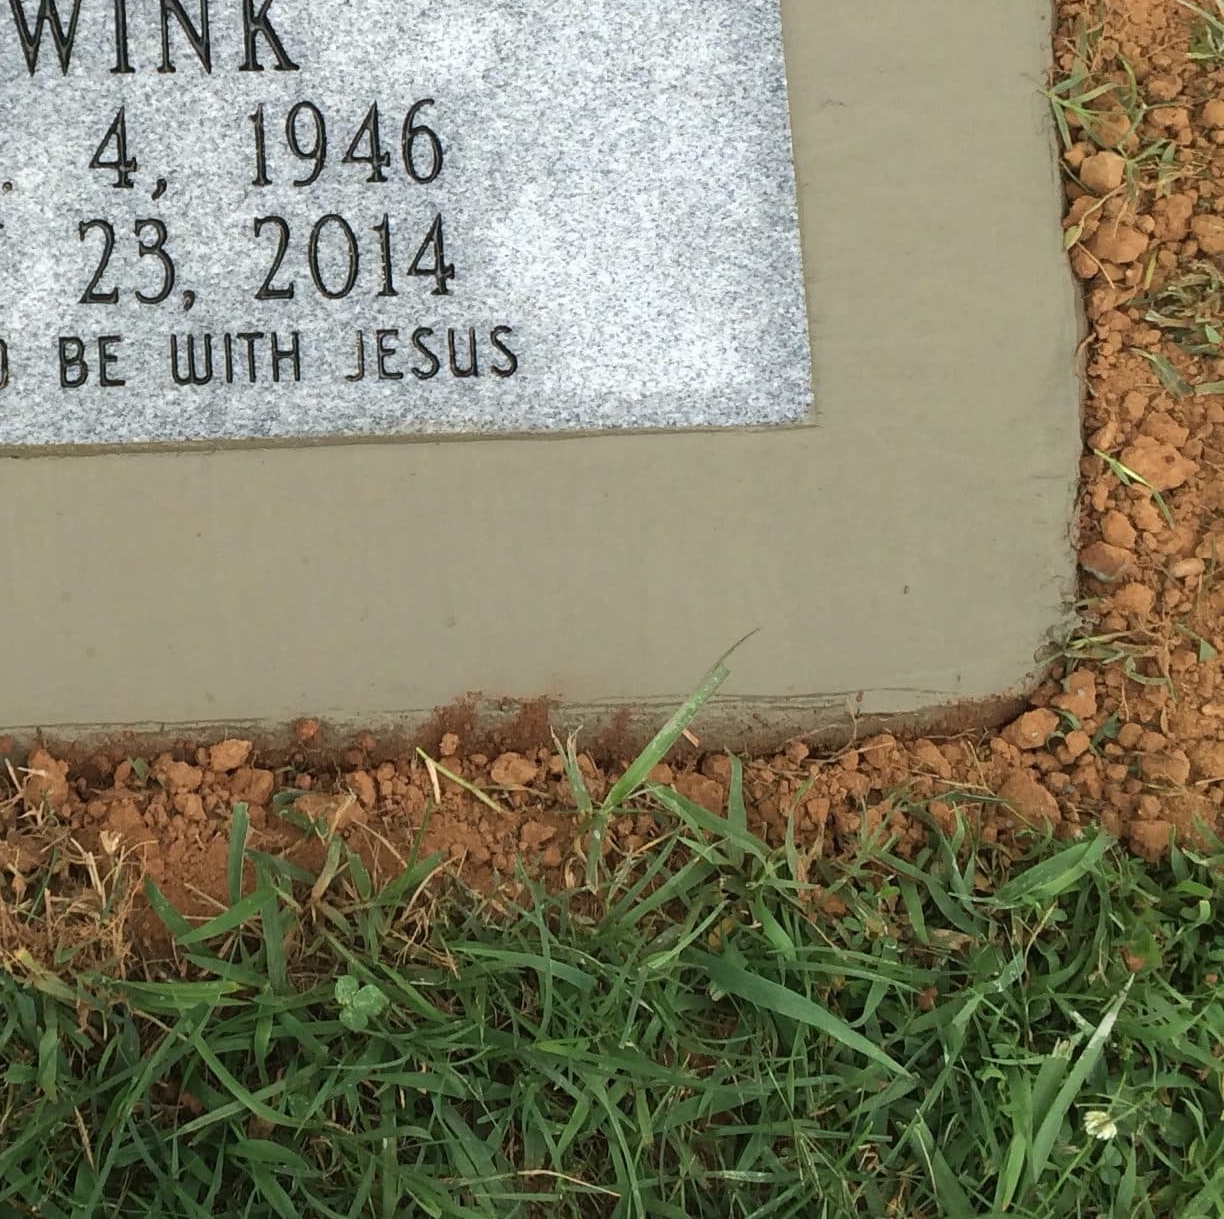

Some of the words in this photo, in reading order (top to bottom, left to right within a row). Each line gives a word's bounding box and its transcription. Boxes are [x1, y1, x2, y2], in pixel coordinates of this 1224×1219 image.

[88, 105, 169, 201] 4,
[248, 97, 446, 188] 1946
[77, 216, 198, 312] 23,
[252, 212, 457, 302] 2014
[57, 334, 127, 390] BE
[169, 330, 302, 387] WITH
[345, 324, 519, 383] JESUS
